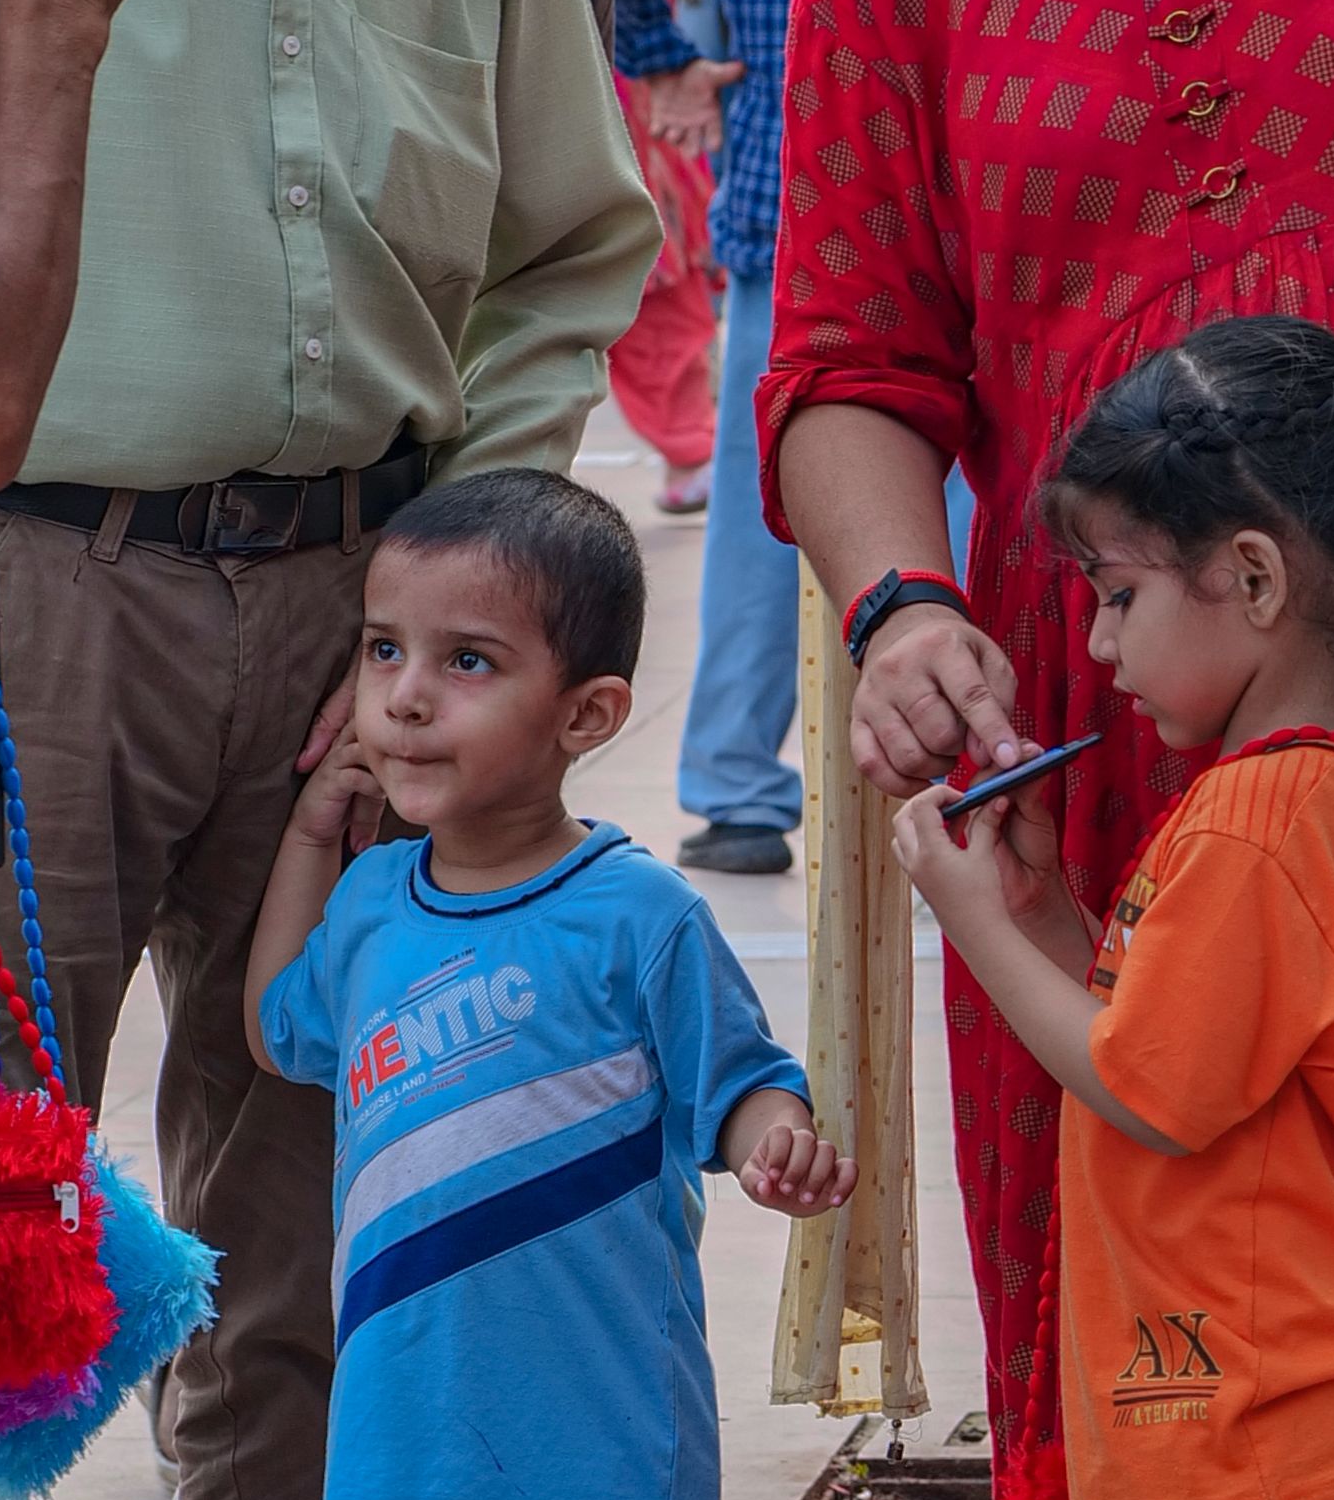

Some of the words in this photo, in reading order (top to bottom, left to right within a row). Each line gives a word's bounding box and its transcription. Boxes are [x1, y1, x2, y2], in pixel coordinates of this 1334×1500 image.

[362, 1008, 388, 1037] YORK
[393, 1072, 427, 1097] LAND
[1133, 1401, 1208, 1427] ATHLETIC
